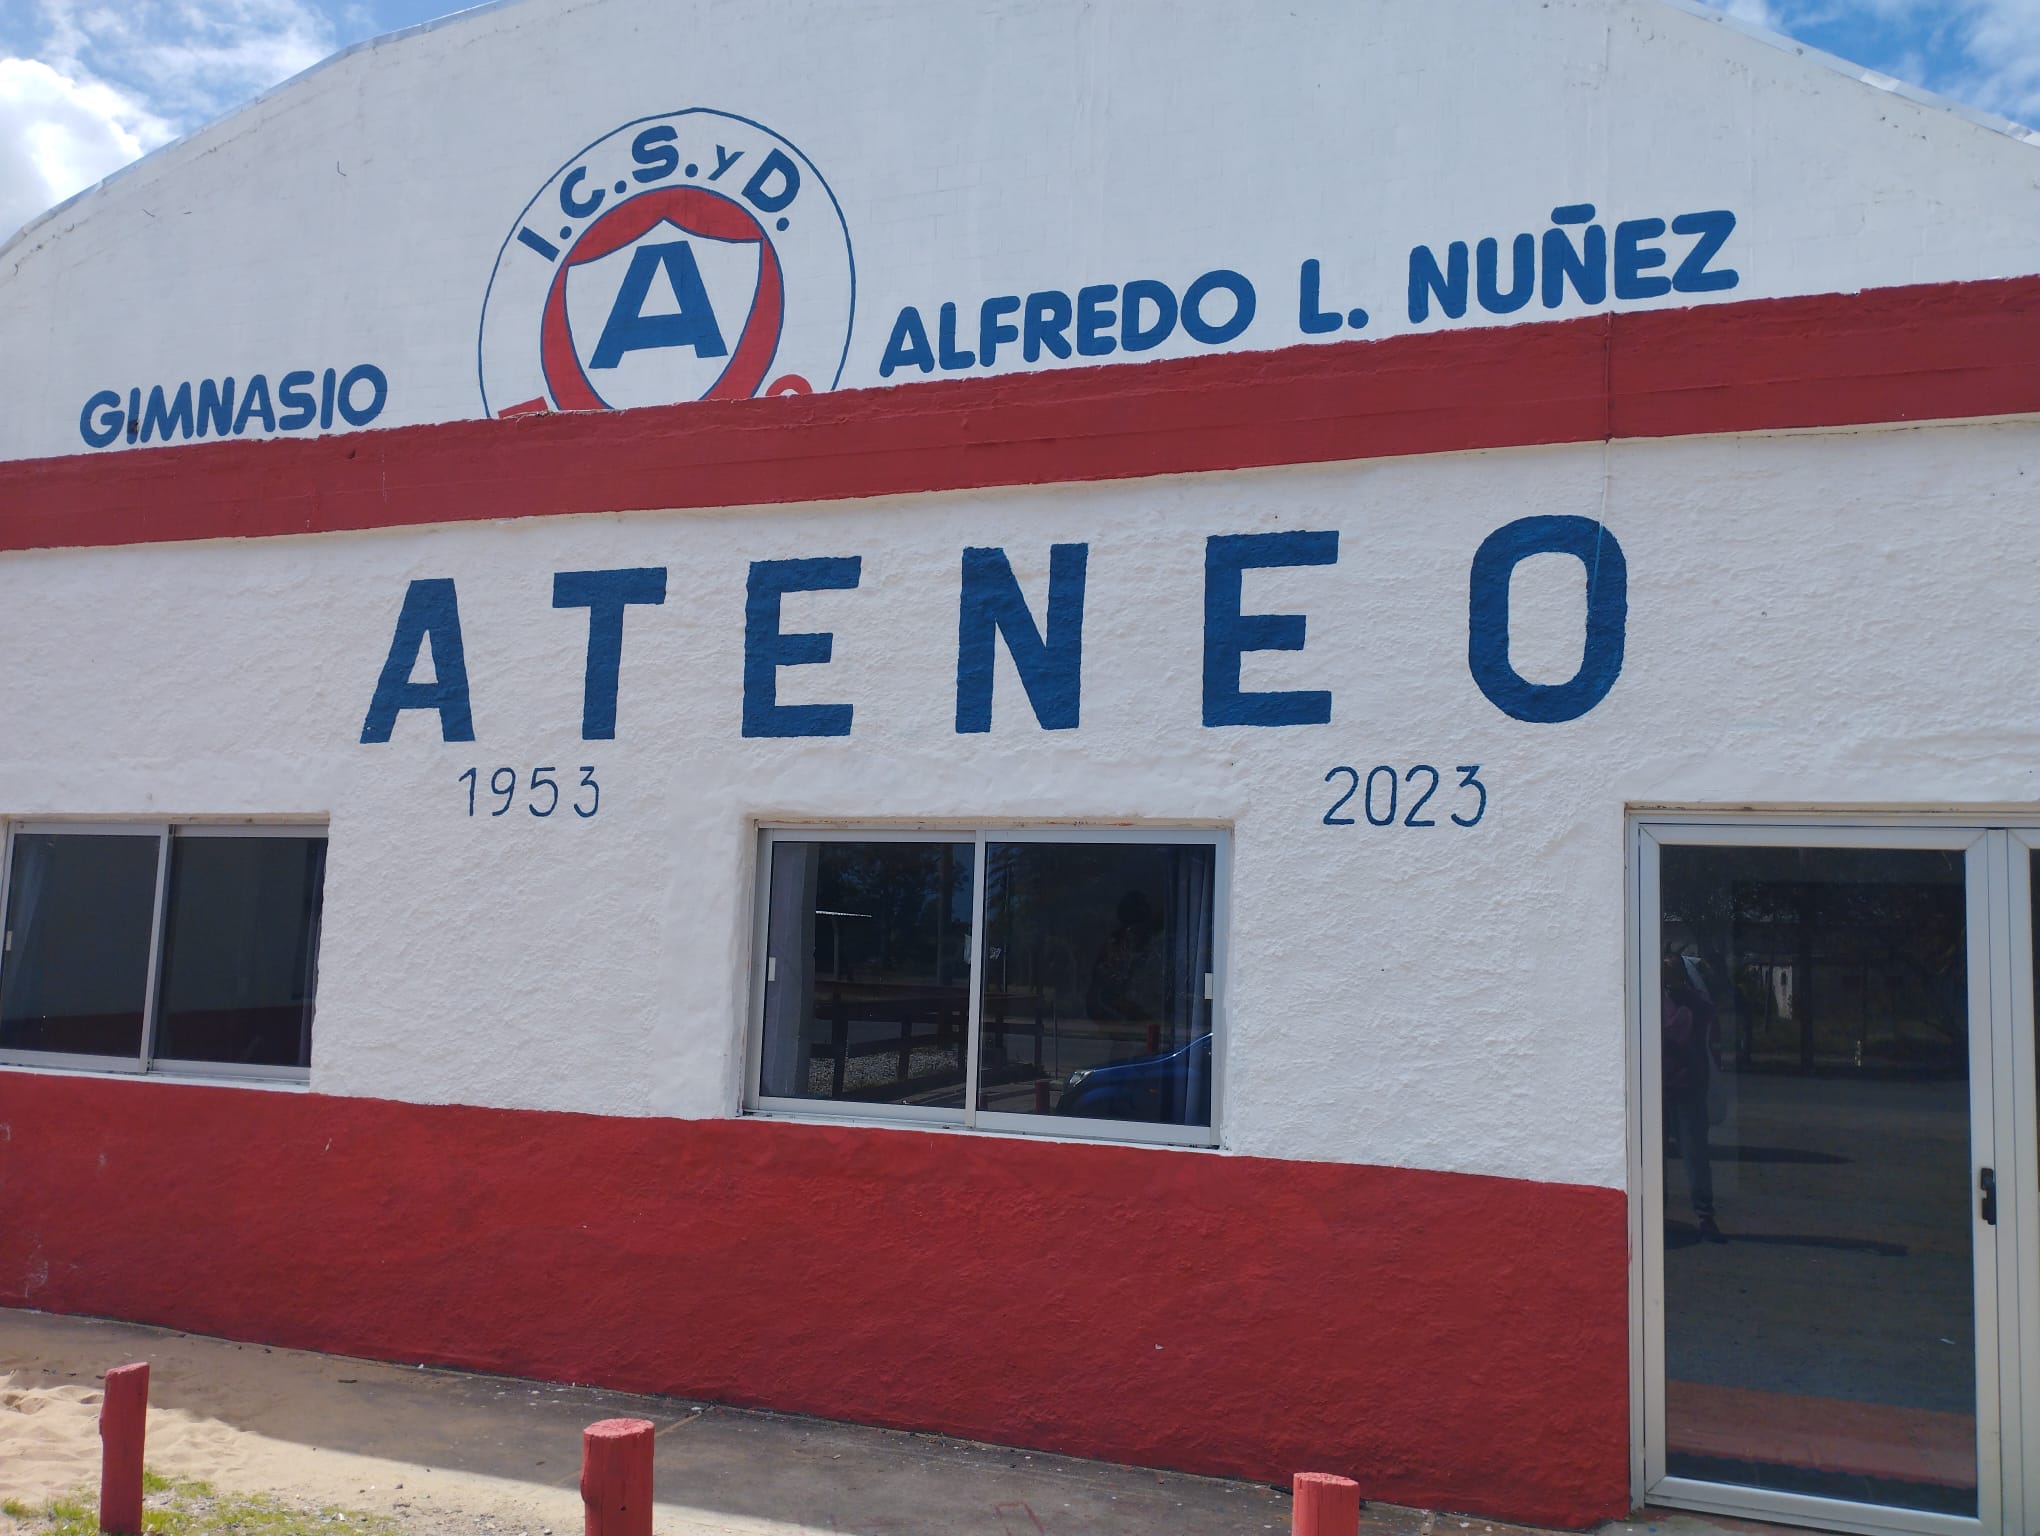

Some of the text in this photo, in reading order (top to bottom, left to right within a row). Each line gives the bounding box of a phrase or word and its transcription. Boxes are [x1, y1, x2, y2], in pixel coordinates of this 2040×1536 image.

[588, 240, 729, 370] A
[879, 203, 1740, 378] ALFREDO L. NUÑEZ
[79, 363, 388, 449] GIMNASIO
[359, 513, 1629, 745] ATENEO
[459, 765, 602, 819] 1953
[1322, 763, 1488, 829] 2023
